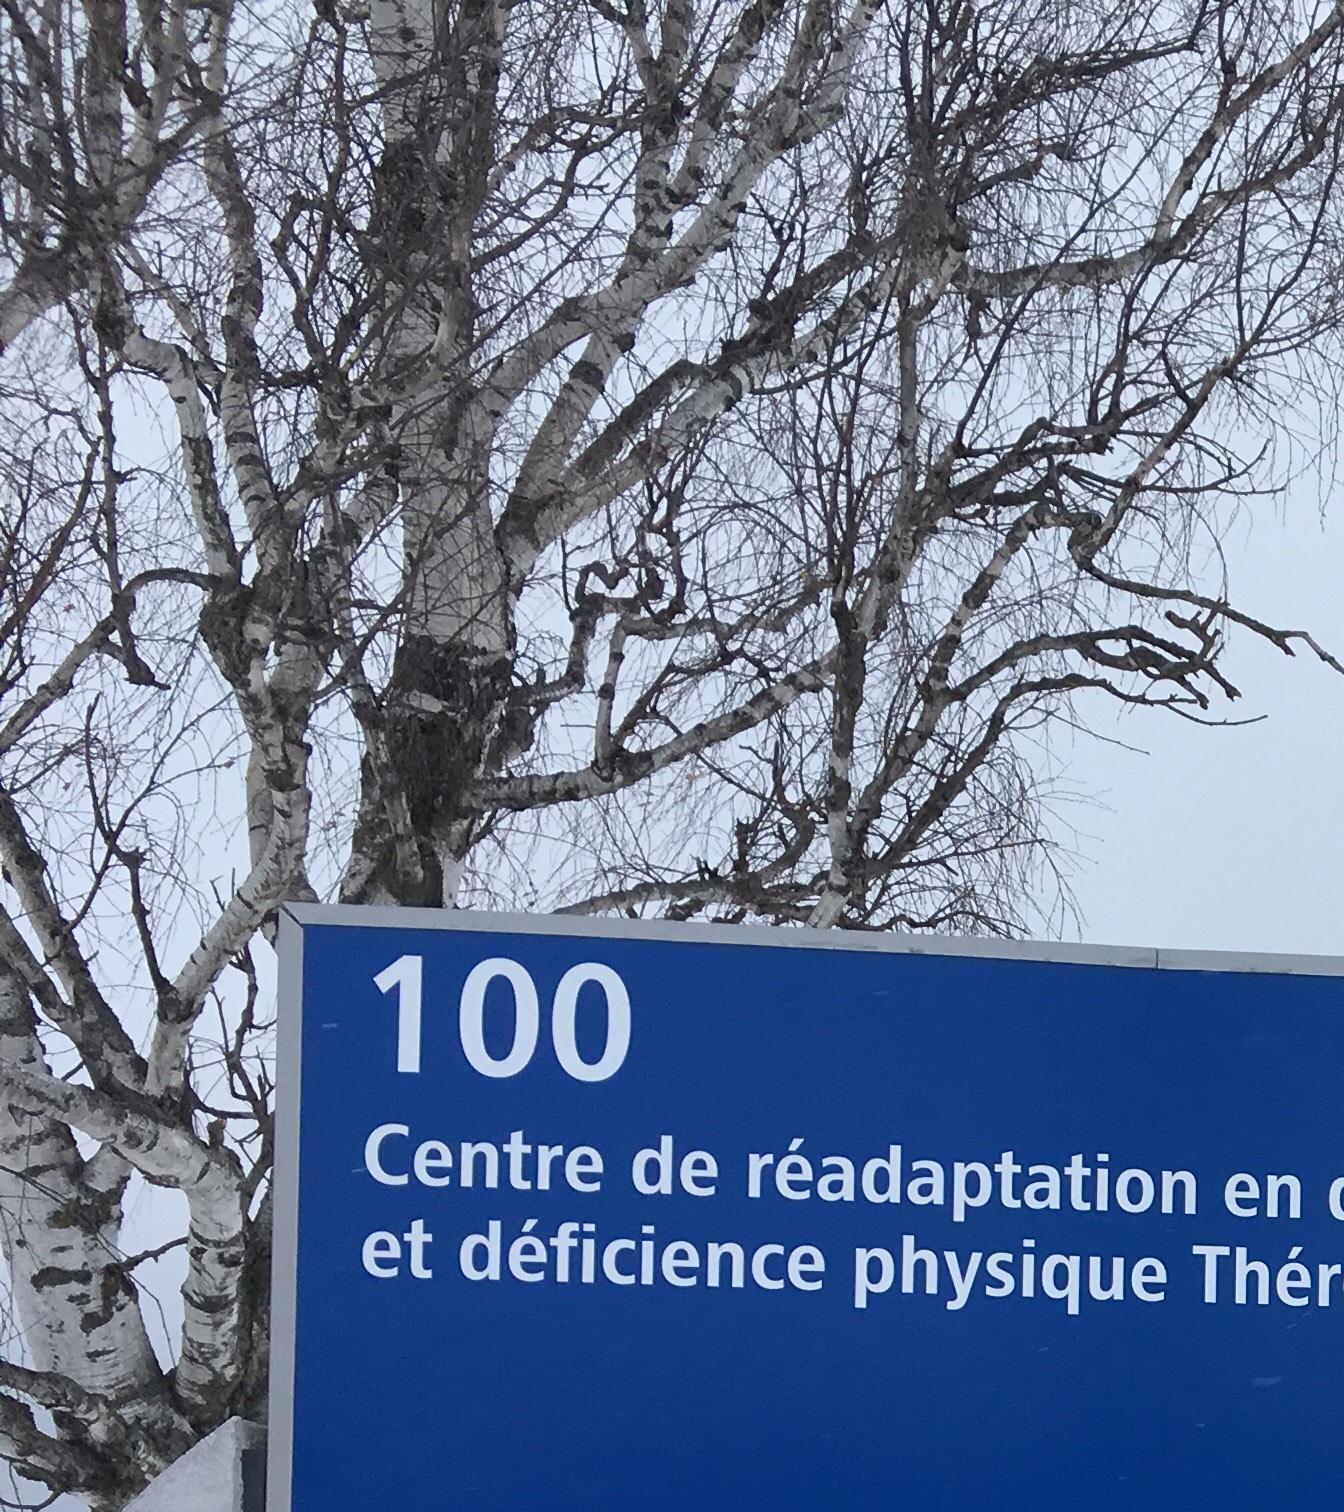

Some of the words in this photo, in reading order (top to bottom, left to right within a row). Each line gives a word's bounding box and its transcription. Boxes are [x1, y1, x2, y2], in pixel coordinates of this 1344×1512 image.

[373, 954, 631, 1082] 100
[364, 1123, 604, 1193] Centre
[632, 1134, 718, 1198] de
[748, 1138, 1197, 1222] réadaptation
[1224, 1173, 1301, 1219] en
[362, 1218, 433, 1279] et
[459, 1218, 825, 1291] déficience
[854, 1234, 1167, 1315] physique
